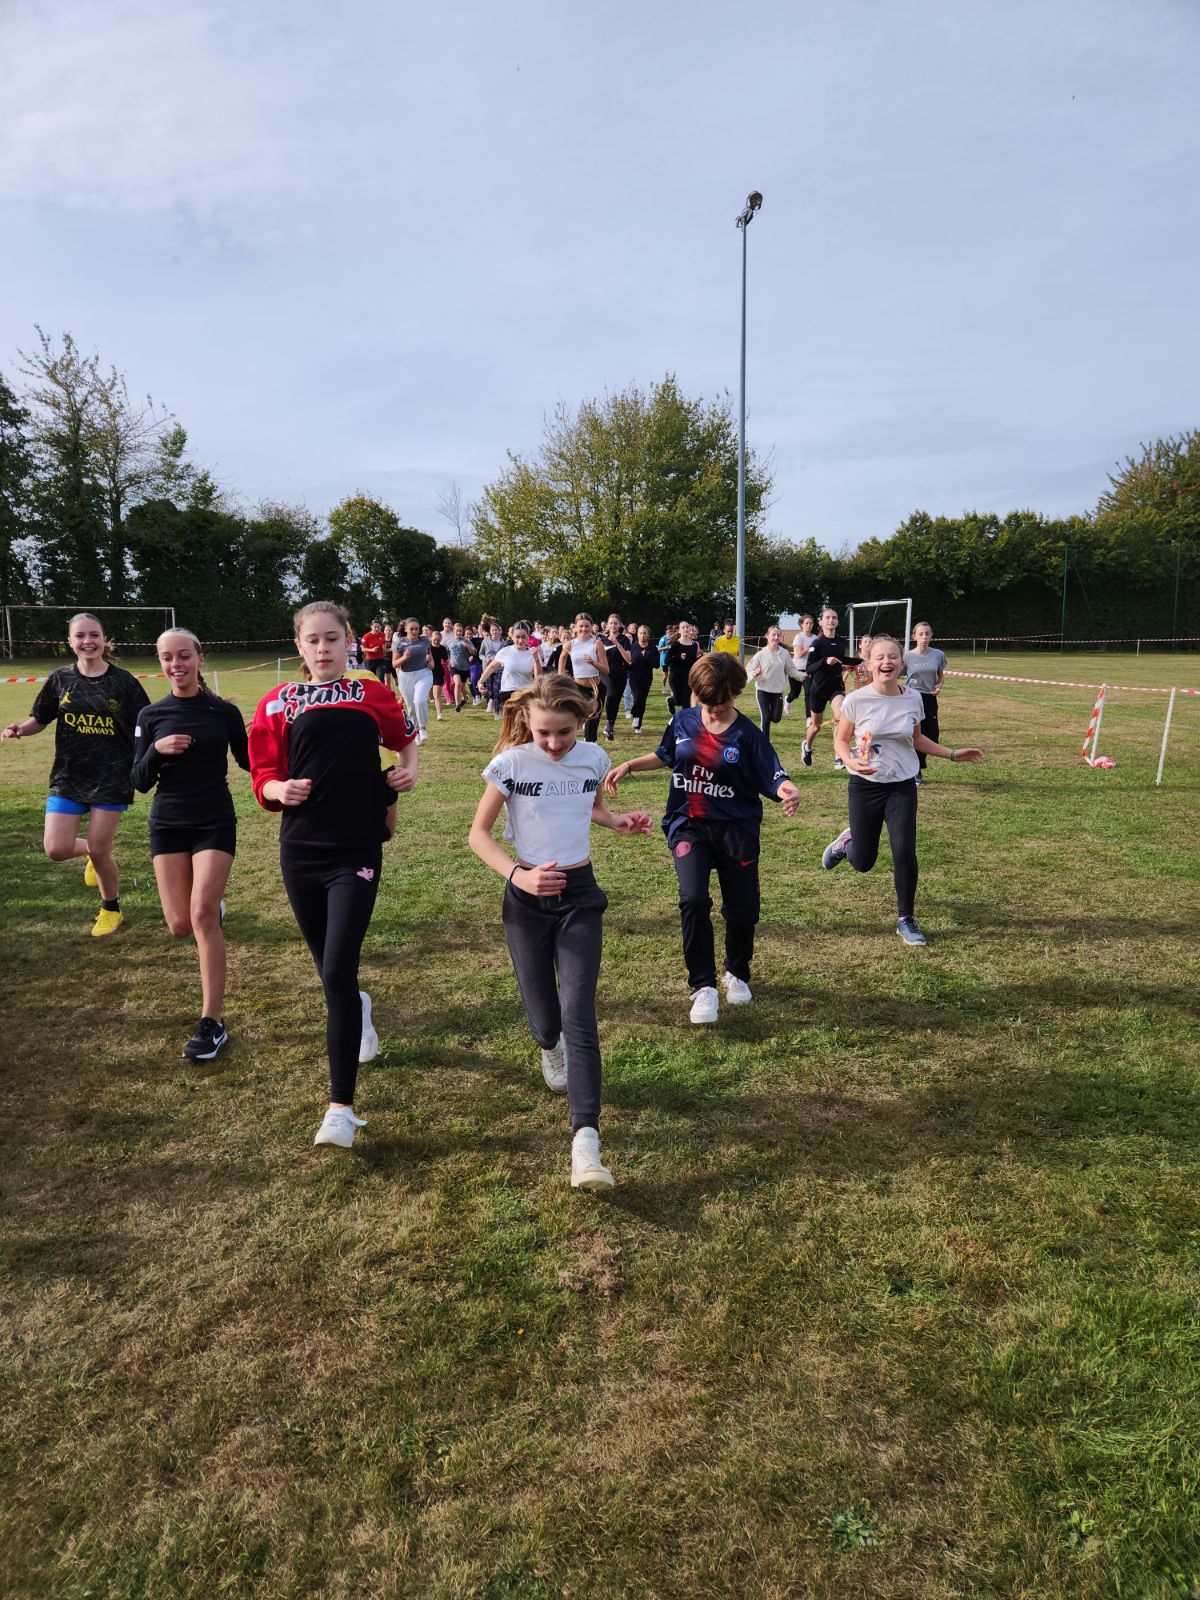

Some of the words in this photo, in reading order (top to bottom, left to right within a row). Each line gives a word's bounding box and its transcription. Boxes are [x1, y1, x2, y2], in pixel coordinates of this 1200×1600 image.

[278, 680, 366, 723] Start
[64, 712, 114, 728] QATAR
[76, 725, 115, 736] AIRWAYS
[692, 765, 714, 780] Fly
[515, 781, 543, 796] NIKE
[545, 780, 580, 796] AIR
